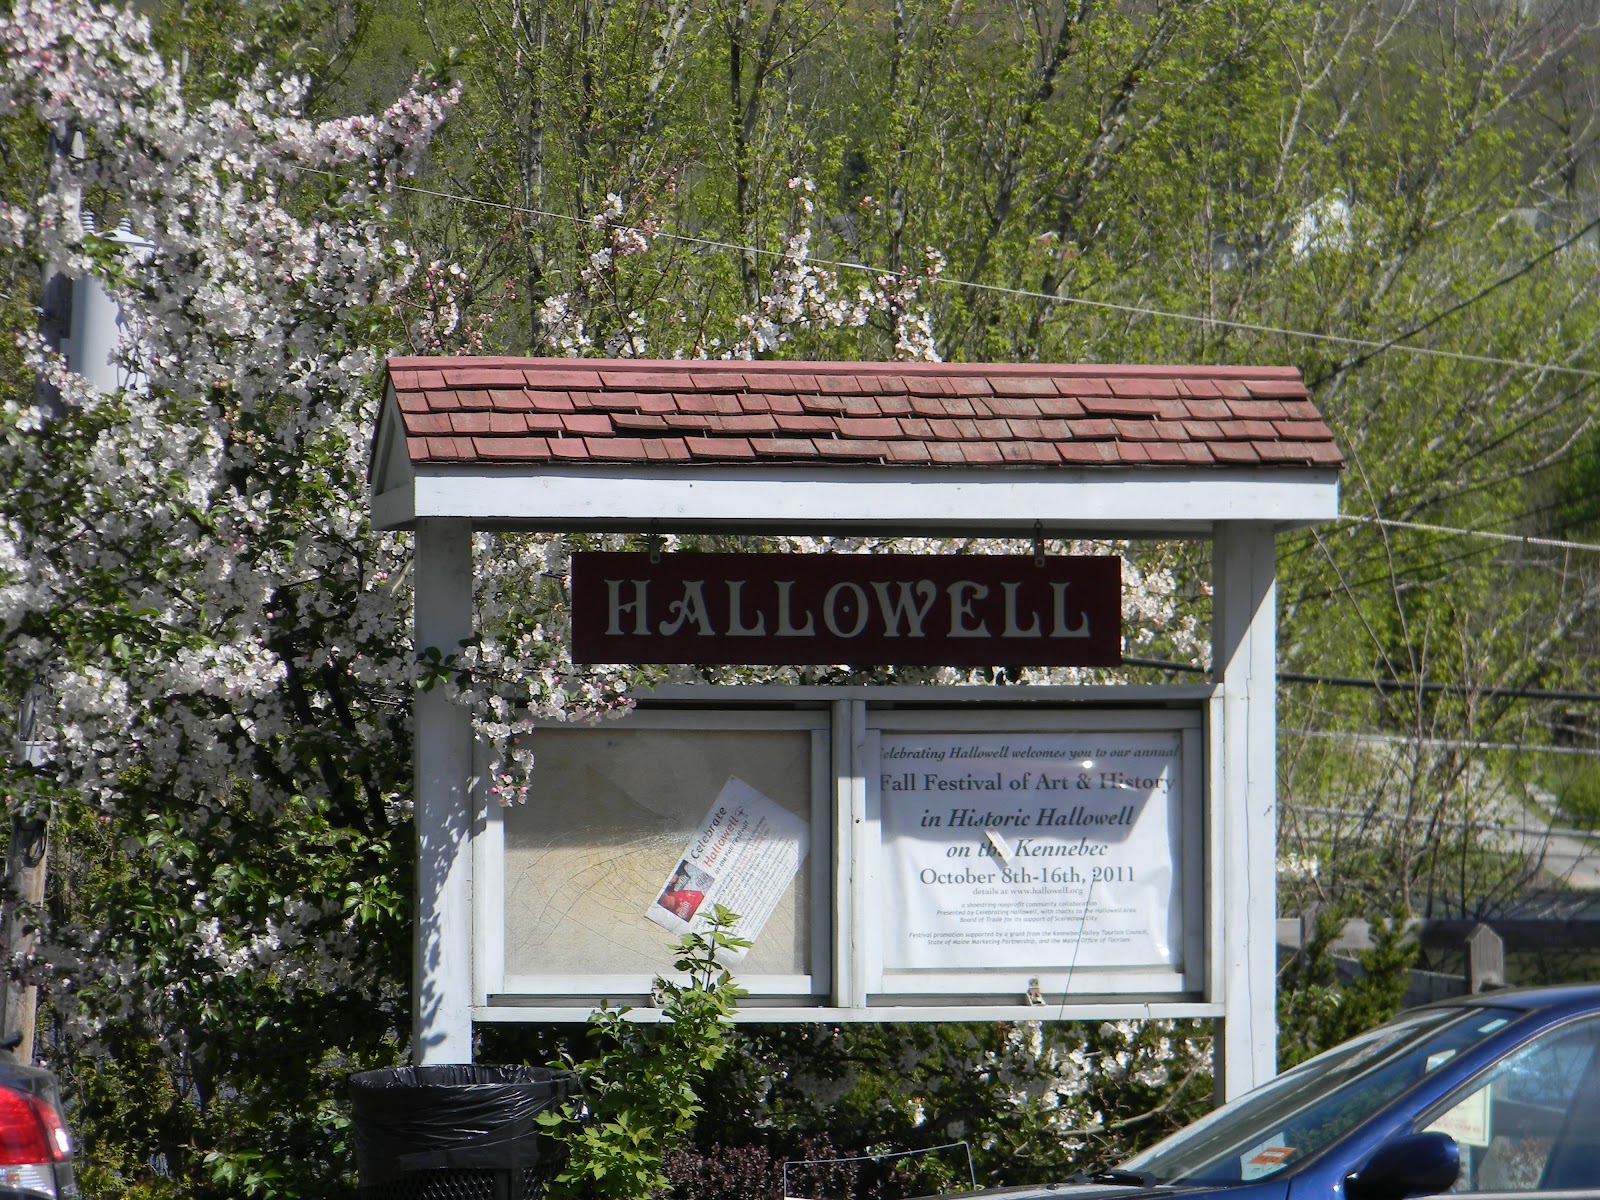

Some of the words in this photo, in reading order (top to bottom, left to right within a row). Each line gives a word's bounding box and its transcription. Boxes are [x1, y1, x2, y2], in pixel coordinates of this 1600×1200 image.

[603, 579, 1092, 639] HALLOWELL
[881, 747, 946, 761] elebrating
[948, 746, 1010, 759] Hallowell
[1012, 746, 1065, 758] welcomes
[1070, 749, 1091, 761] you
[1095, 748, 1106, 758] to
[1110, 749, 1131, 758] our
[1133, 744, 1180, 758] annual
[880, 773, 916, 791] Fall
[922, 772, 1003, 791] Festival
[1009, 771, 1030, 791] of
[1034, 773, 1069, 790] Art
[1076, 772, 1092, 790] &
[1099, 772, 1176, 794] History
[920, 809, 941, 828] in
[946, 808, 1030, 828] Historic
[1035, 806, 1135, 827] Hallowell
[690, 807, 727, 859] Celebrate
[703, 815, 739, 868] Hallowell
[946, 844, 970, 858] on
[1014, 837, 1108, 858] Kennebec
[719, 857, 727, 867] the
[919, 868, 996, 885] October
[1001, 866, 1086, 885] 8th-16th,
[1093, 866, 1135, 882] 2011
[972, 887, 999, 896] details
[1000, 888, 1009, 896] at
[1010, 886, 1084, 897] www.hallowell.org
[975, 908, 1009, 917] Celebrating
[1046, 915, 1054, 923] of
[933, 932, 964, 940] promotion
[965, 931, 994, 939] supported
[1010, 931, 1025, 939] grant
[1027, 930, 1040, 938] from
[1101, 929, 1125, 937] Tourism
[970, 938, 1000, 947] Marketing
